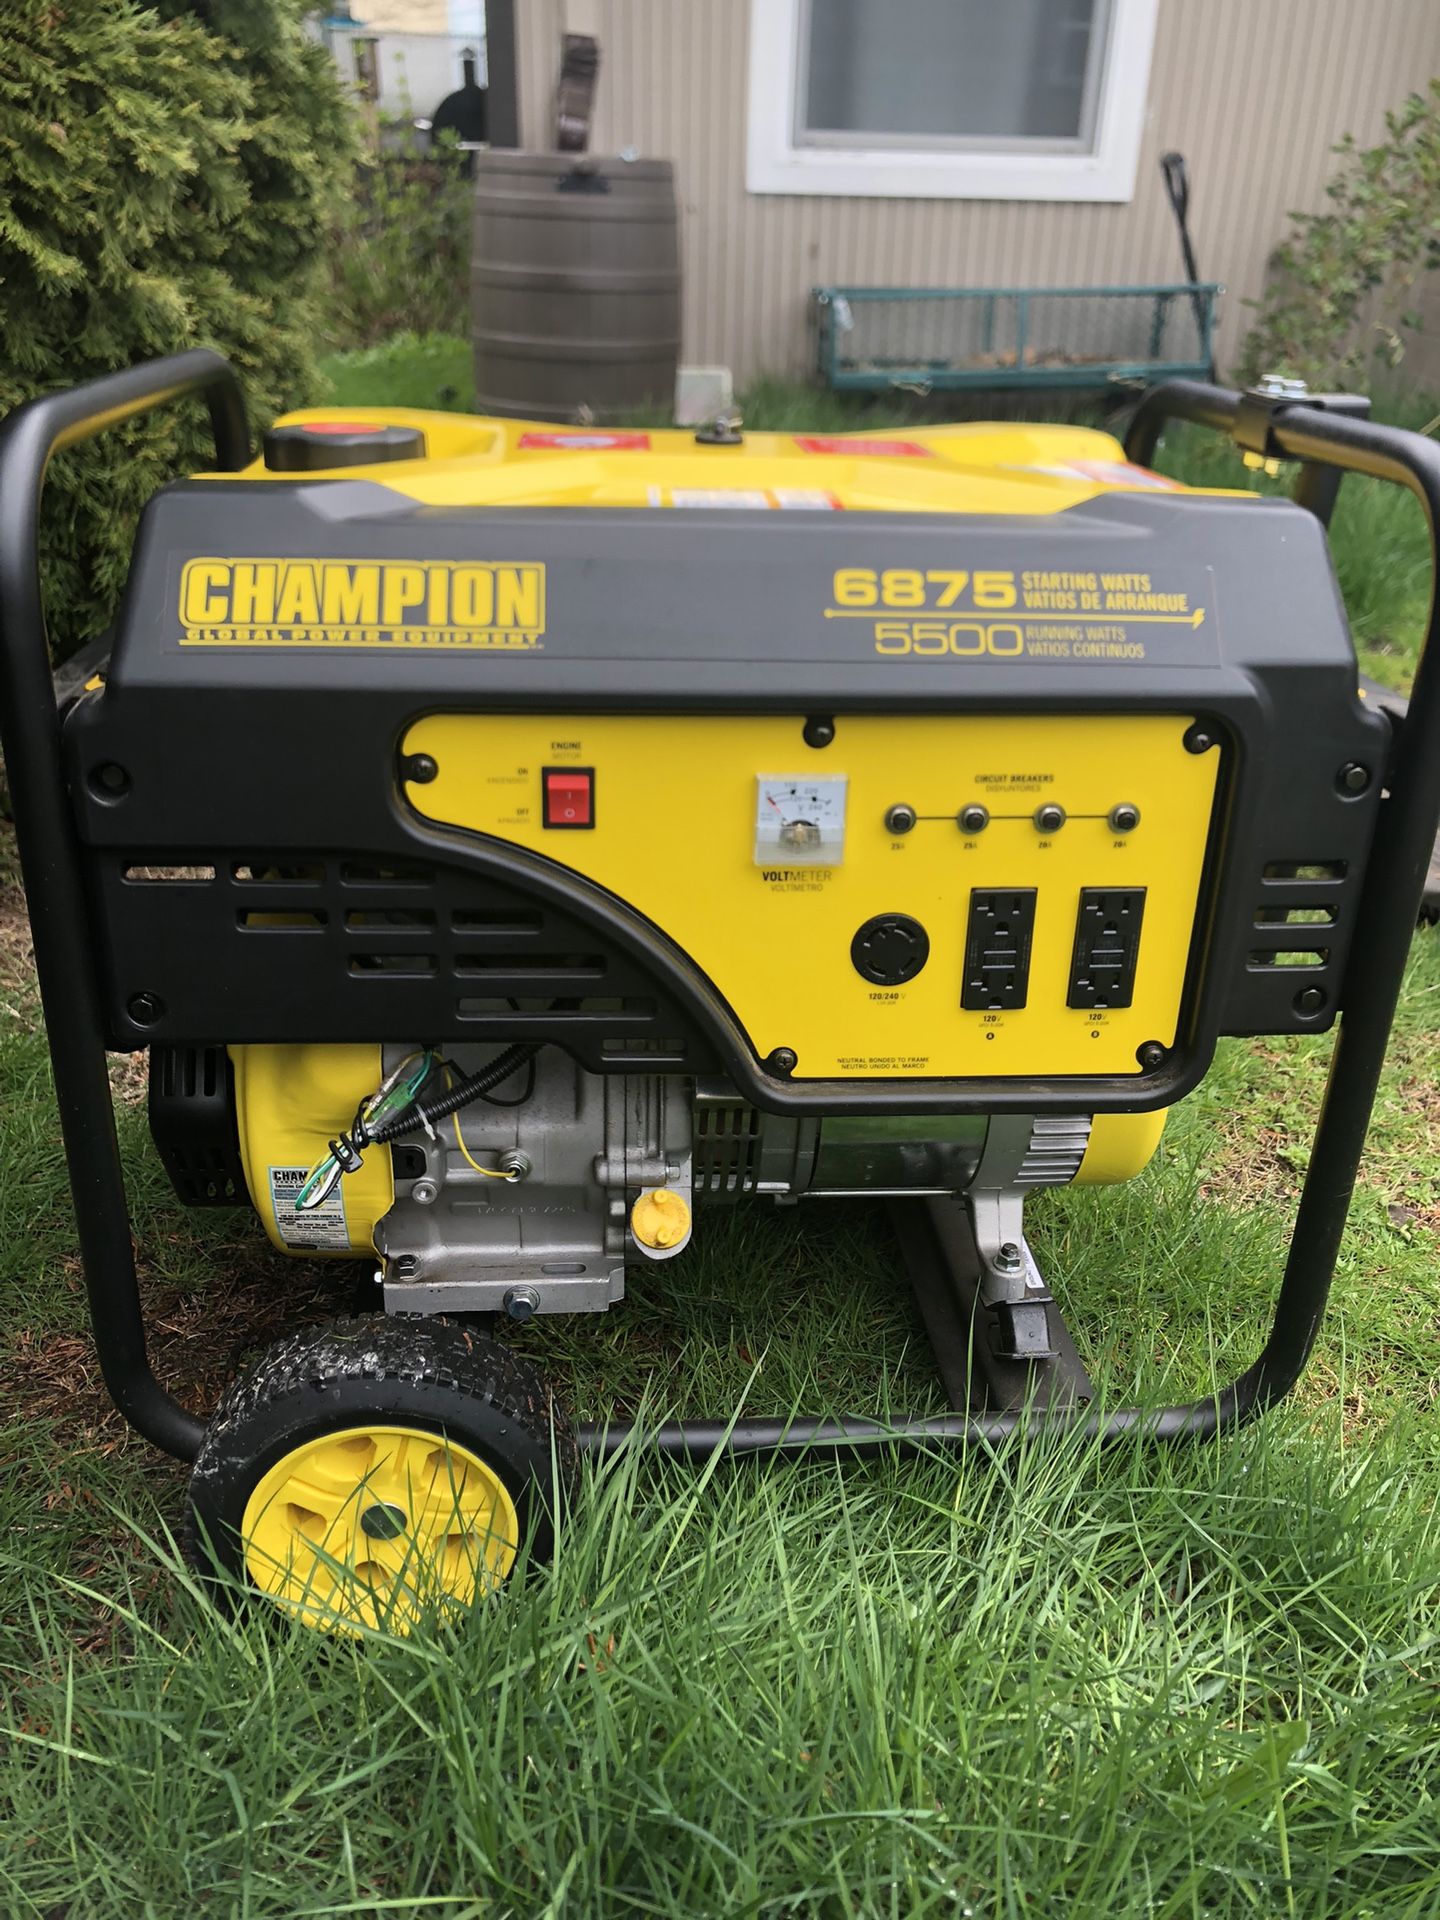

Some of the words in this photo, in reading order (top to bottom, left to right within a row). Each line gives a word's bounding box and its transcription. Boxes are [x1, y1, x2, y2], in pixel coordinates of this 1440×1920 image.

[833, 568, 1017, 608] 6875
[1022, 571, 1097, 591] STARTING
[1101, 573, 1151, 592] WATTS
[184, 563, 540, 627] CHAMPION
[1023, 592, 1077, 608] VATIOS
[1081, 592, 1100, 609] DE
[1106, 593, 1188, 612] ARRANQUE
[187, 629, 282, 641] GLOBAL
[297, 630, 379, 642] POWER
[392, 632, 537, 645] EQUIPMENT
[874, 622, 1024, 657] 5500
[1026, 625, 1083, 640] RUNNING
[1086, 626, 1126, 641] WATTS
[1027, 642, 1069, 657] VATIOS
[1073, 643, 1144, 659] CONTINUOS
[1010, 775, 1054, 783] BREAKERS
[763, 871, 831, 881] VOLTMETER
